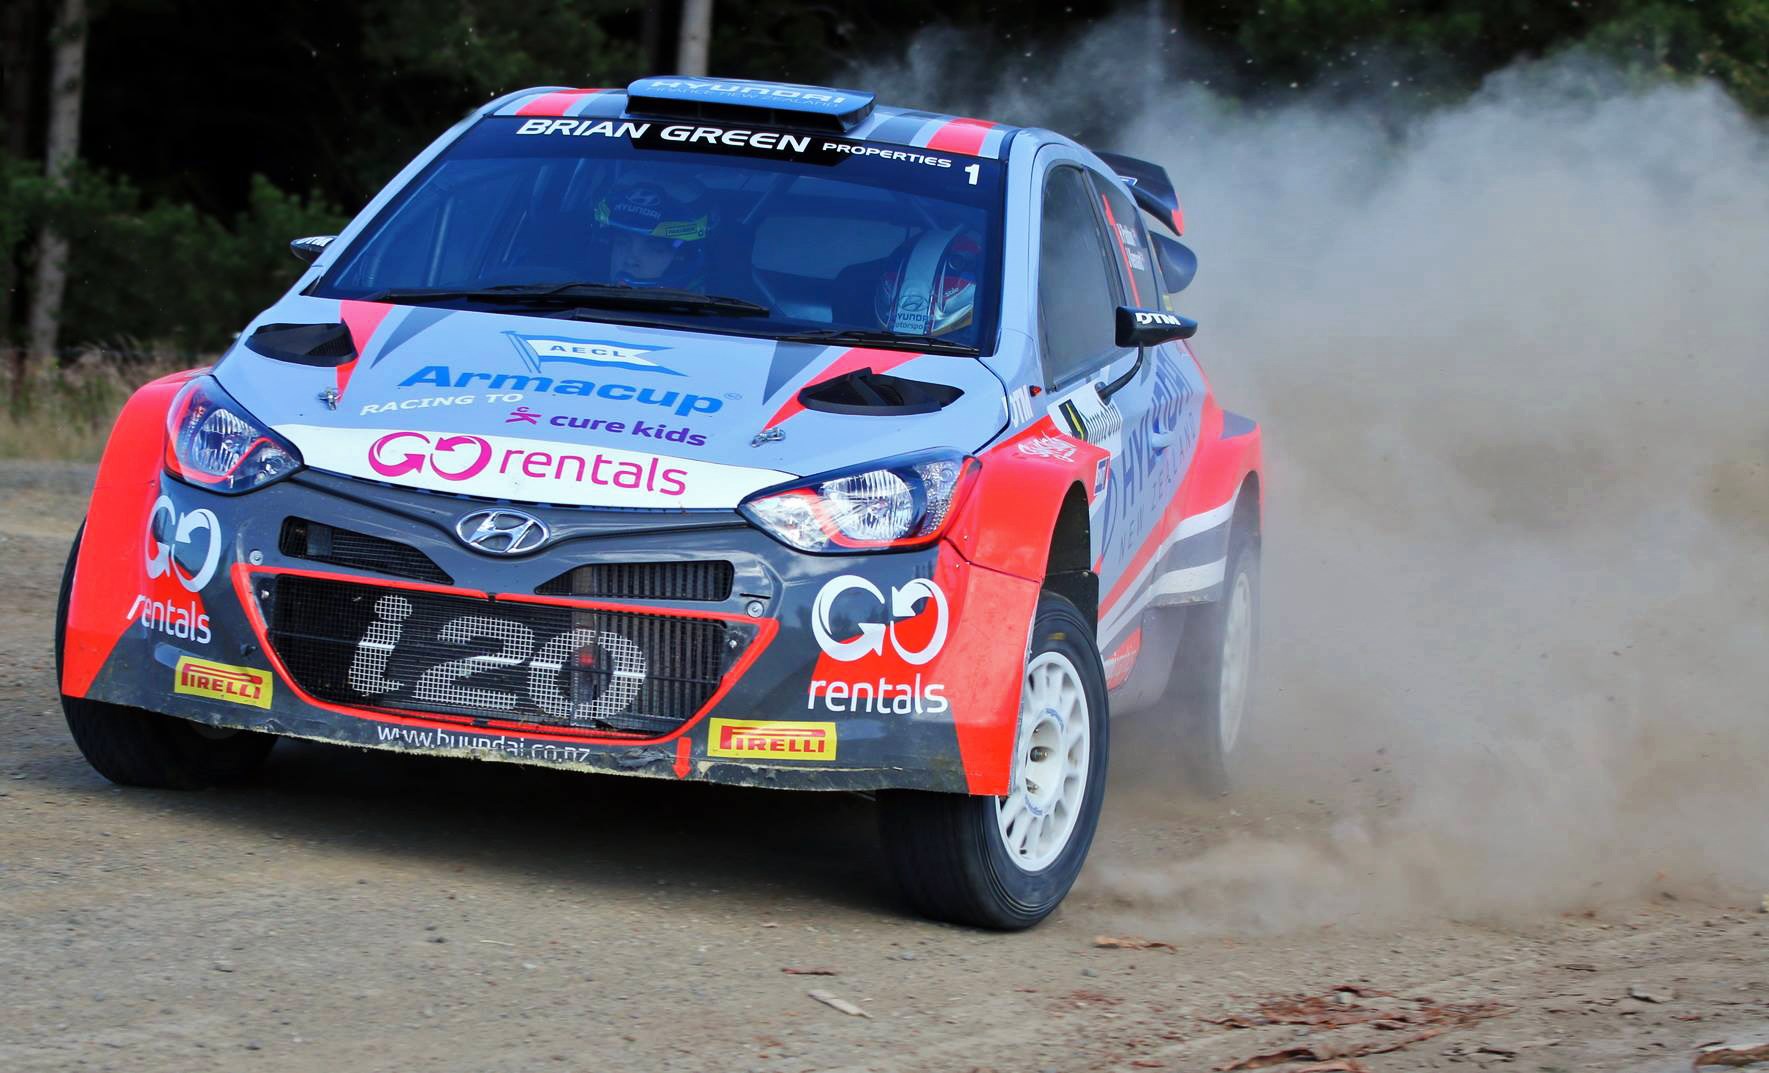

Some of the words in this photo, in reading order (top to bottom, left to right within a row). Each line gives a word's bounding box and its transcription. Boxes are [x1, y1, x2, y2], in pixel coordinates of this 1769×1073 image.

[651, 81, 848, 103] HYUNDAI
[516, 119, 650, 140] BRIAN
[660, 125, 811, 152] GREEN
[822, 142, 952, 168] PROPERTIES
[964, 163, 981, 185] 1
[1135, 312, 1181, 326] DTM
[549, 344, 631, 359] AECL
[360, 394, 473, 416] RACING
[485, 393, 525, 404] TO
[397, 365, 724, 417] Armacup
[549, 415, 628, 437] cure
[631, 420, 708, 447] kids
[368, 431, 493, 482] GO
[499, 448, 689, 497] rentals
[145, 495, 222, 592] GO
[126, 594, 213, 644] rentals
[811, 574, 950, 666] GO
[348, 594, 648, 720] i20
[181, 662, 264, 700] PIRELLI
[807, 673, 949, 715] rentals
[719, 725, 826, 753] PIRELLI
